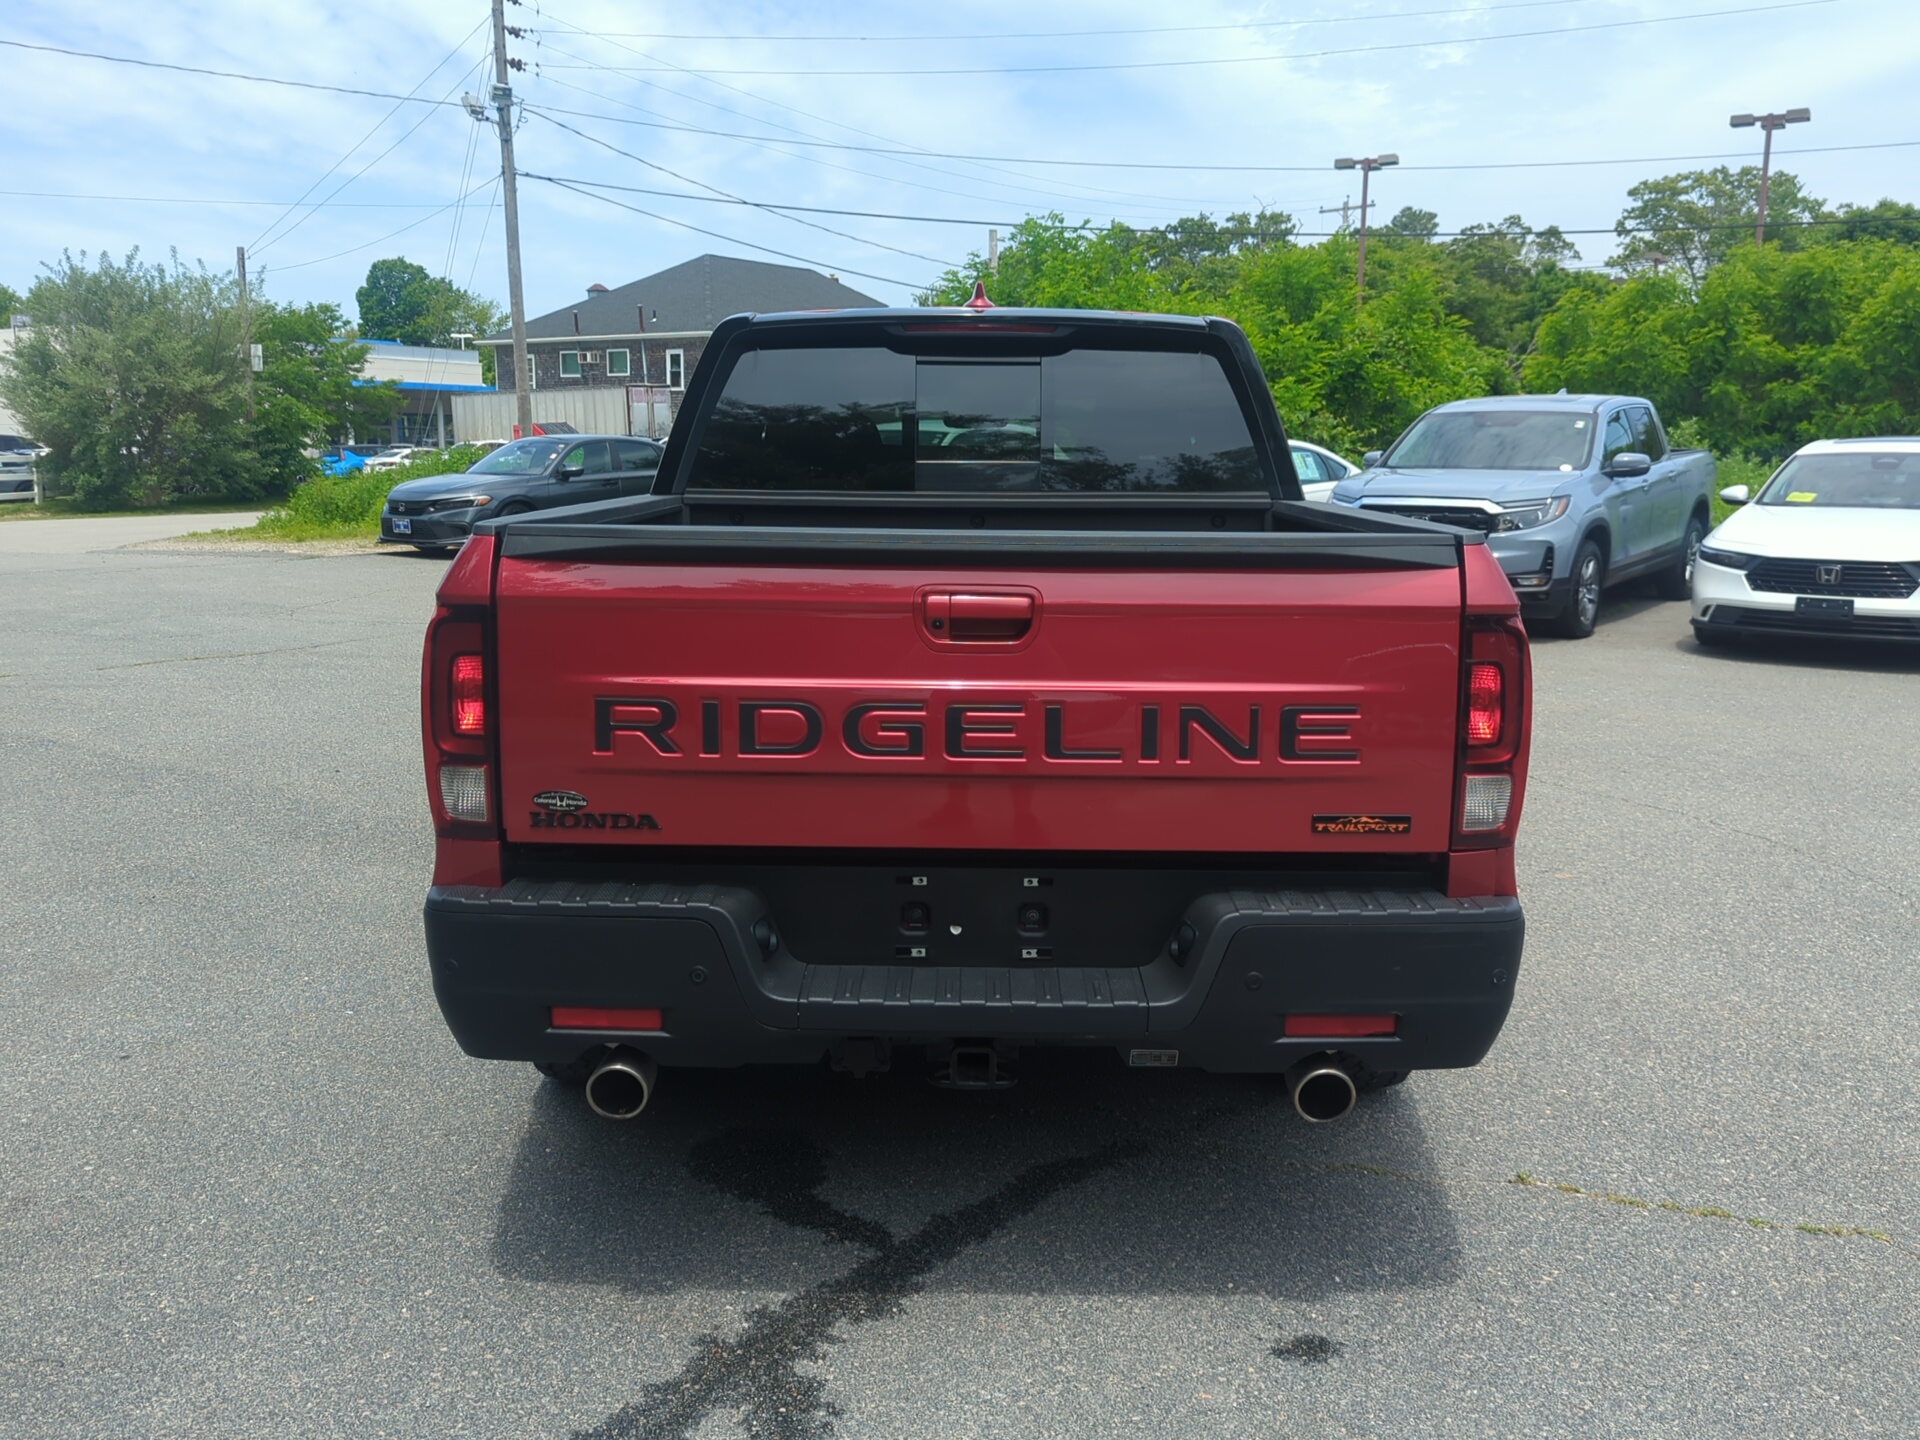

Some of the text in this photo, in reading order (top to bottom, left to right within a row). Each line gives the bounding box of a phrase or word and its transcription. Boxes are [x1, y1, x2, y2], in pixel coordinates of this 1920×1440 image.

[593, 697, 1361, 764] RIDGELINE
[529, 812, 662, 829] HONDA
[1315, 823, 1408, 832] TRAILSPORT
